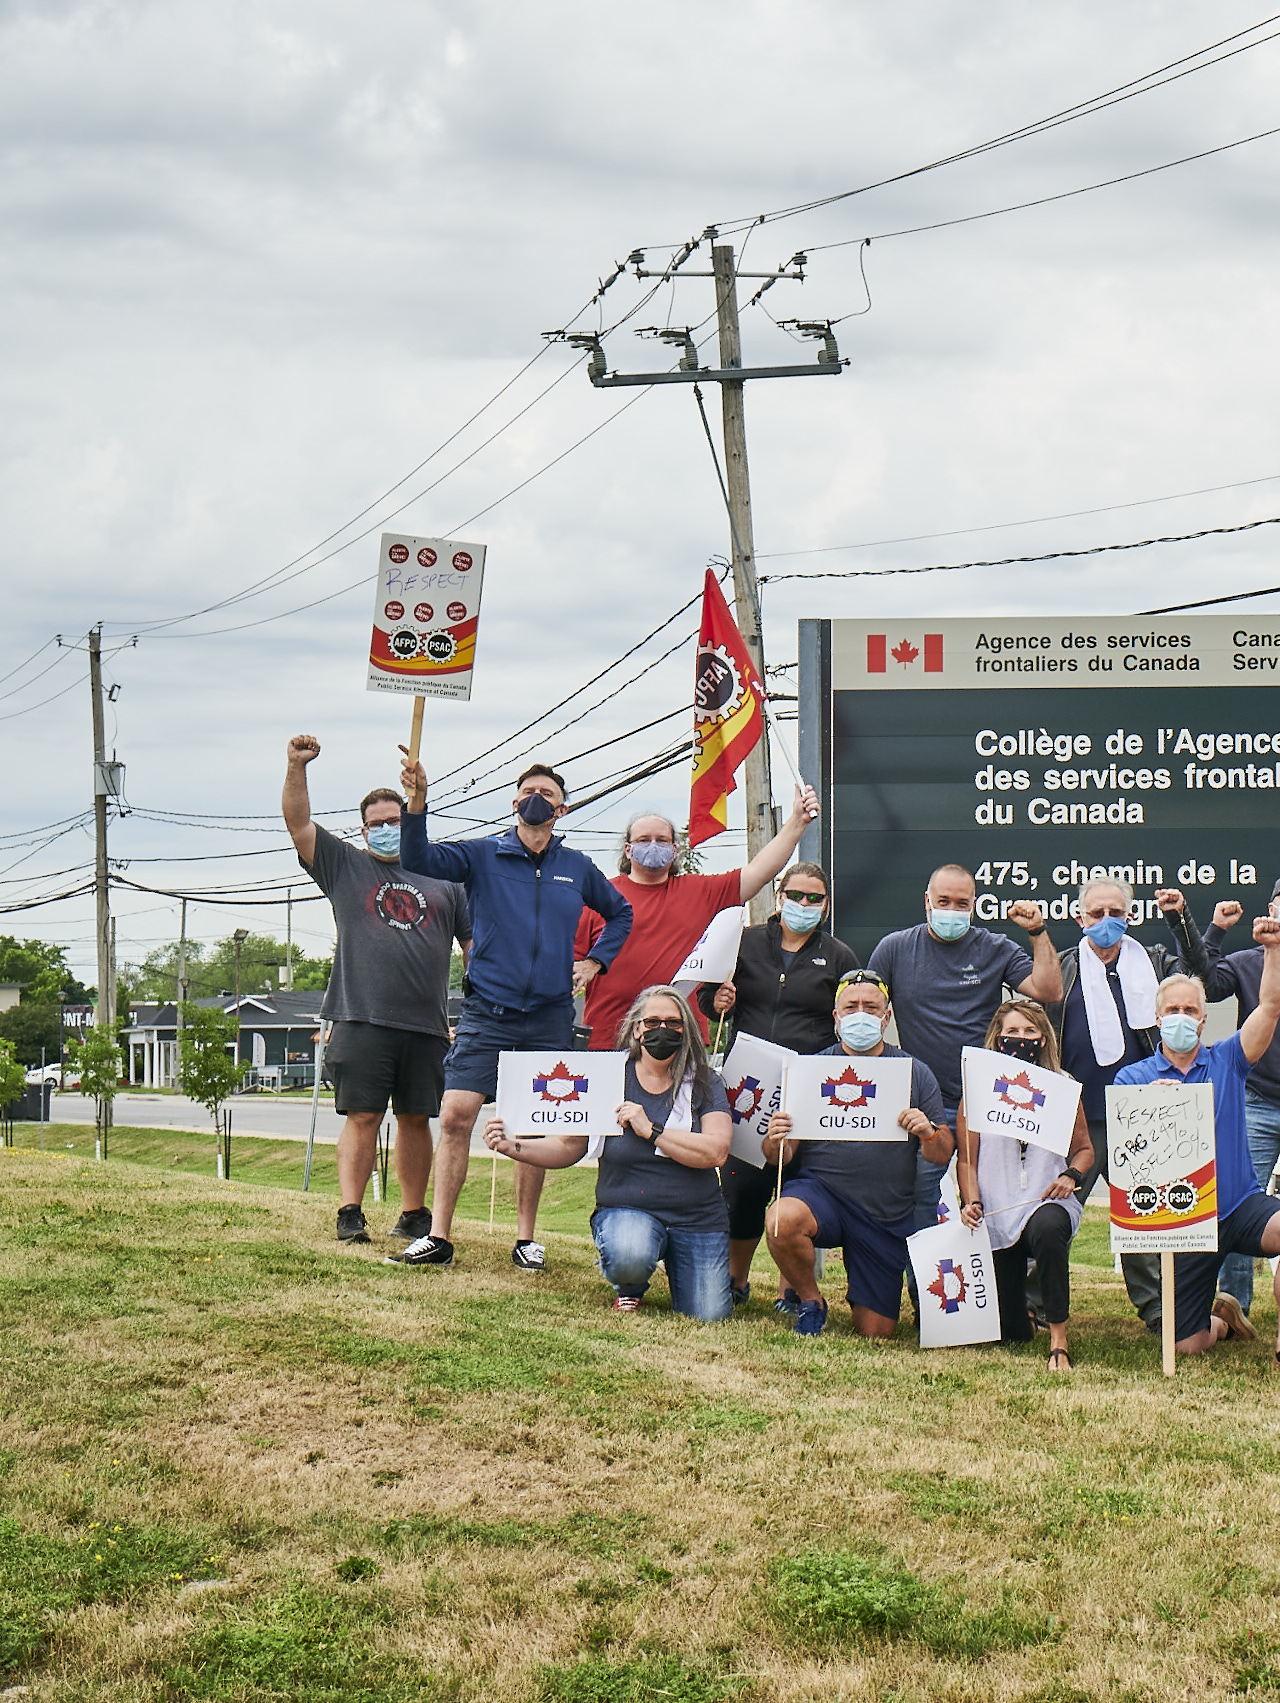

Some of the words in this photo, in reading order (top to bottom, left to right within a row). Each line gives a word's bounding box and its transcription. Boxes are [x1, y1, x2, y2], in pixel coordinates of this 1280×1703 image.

[386, 568, 470, 596] RESPECT
[394, 637, 416, 649] AFPC
[429, 640, 451, 653] PSAC
[976, 633, 1051, 651] Agence
[1060, 633, 1097, 648] des
[1107, 632, 1191, 648] services
[976, 655, 1077, 672] frontaliers
[1088, 655, 1112, 671] du
[1123, 655, 1200, 671] Canada
[976, 728, 1092, 761] Collège
[1106, 729, 1144, 755] de
[975, 765, 1031, 790] des
[1044, 763, 1172, 789] services
[975, 799, 1014, 825] du
[1028, 798, 1145, 824] Canada
[975, 862, 1038, 890] 475,
[1178, 861, 1217, 885] de
[1231, 860, 1256, 884] la
[531, 1111, 588, 1123] CIU-SDI
[819, 1115, 876, 1128] CIU-SDI
[987, 1110, 1041, 1135] CIU-SDI
[1133, 1193, 1156, 1204] AFPC
[1169, 1193, 1193, 1203] PSAC
[970, 1253, 987, 1309] CIU-SDI
